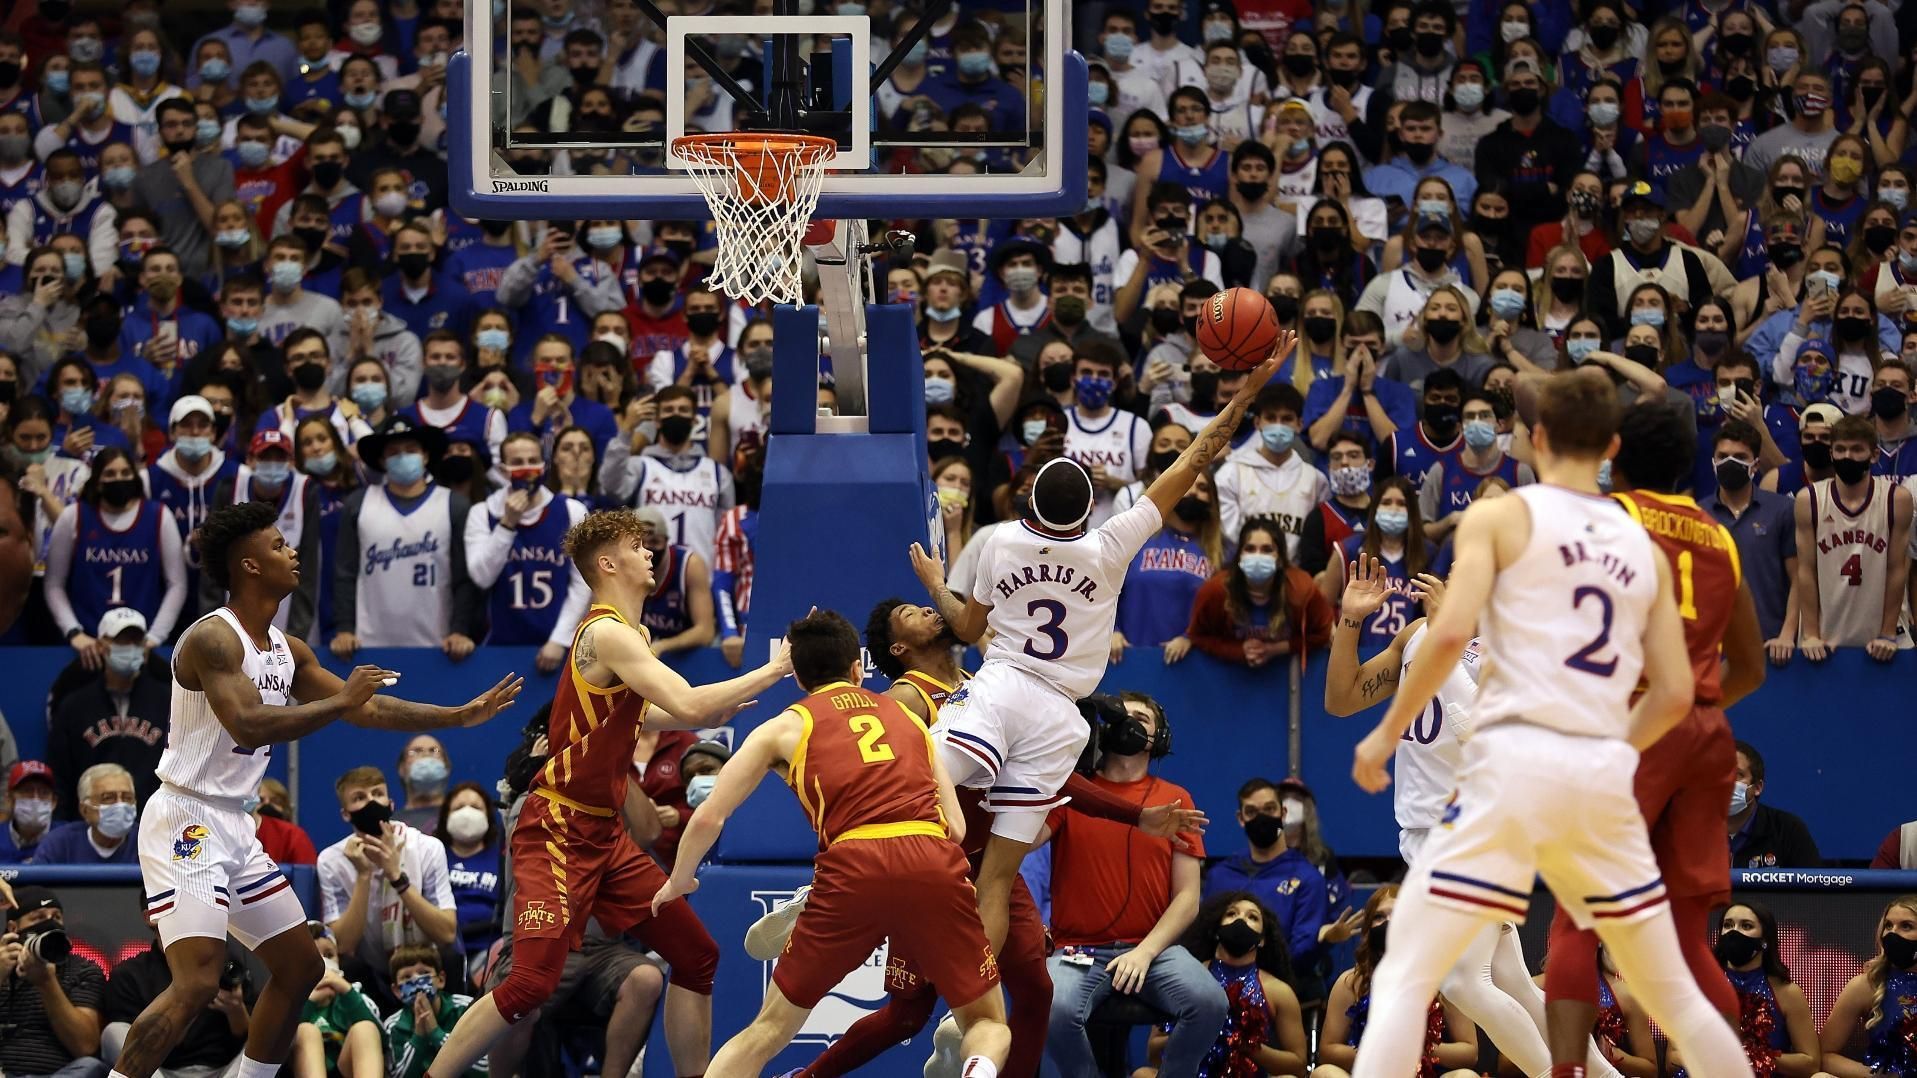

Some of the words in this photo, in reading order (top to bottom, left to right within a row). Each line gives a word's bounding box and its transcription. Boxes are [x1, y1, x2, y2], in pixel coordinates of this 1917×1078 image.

[492, 180, 549, 193] SPALDING
[646, 490, 718, 508] KANSAS
[671, 511, 687, 547] 1
[1817, 529, 1887, 555] KANSAS
[85, 547, 149, 563] KANSAS
[509, 546, 565, 567] ANSAS
[1139, 546, 1216, 580] KANSA
[1840, 554, 1863, 587] 4
[106, 566, 124, 605] 1
[412, 562, 436, 587] 21
[509, 570, 554, 609] 15
[996, 564, 1074, 600] HARRIS
[1071, 575, 1096, 603] JR.
[1677, 550, 1698, 620] 1
[1023, 599, 1069, 661] 3
[1370, 600, 1407, 635] 25
[1564, 585, 1620, 678] 2
[257, 673, 291, 699] ANSAS
[830, 692, 879, 710] GRILL
[848, 714, 896, 763] 2
[1742, 873, 1794, 884] ROCKET
[1797, 873, 1853, 887] Mortgage
[518, 906, 555, 926] STATE
